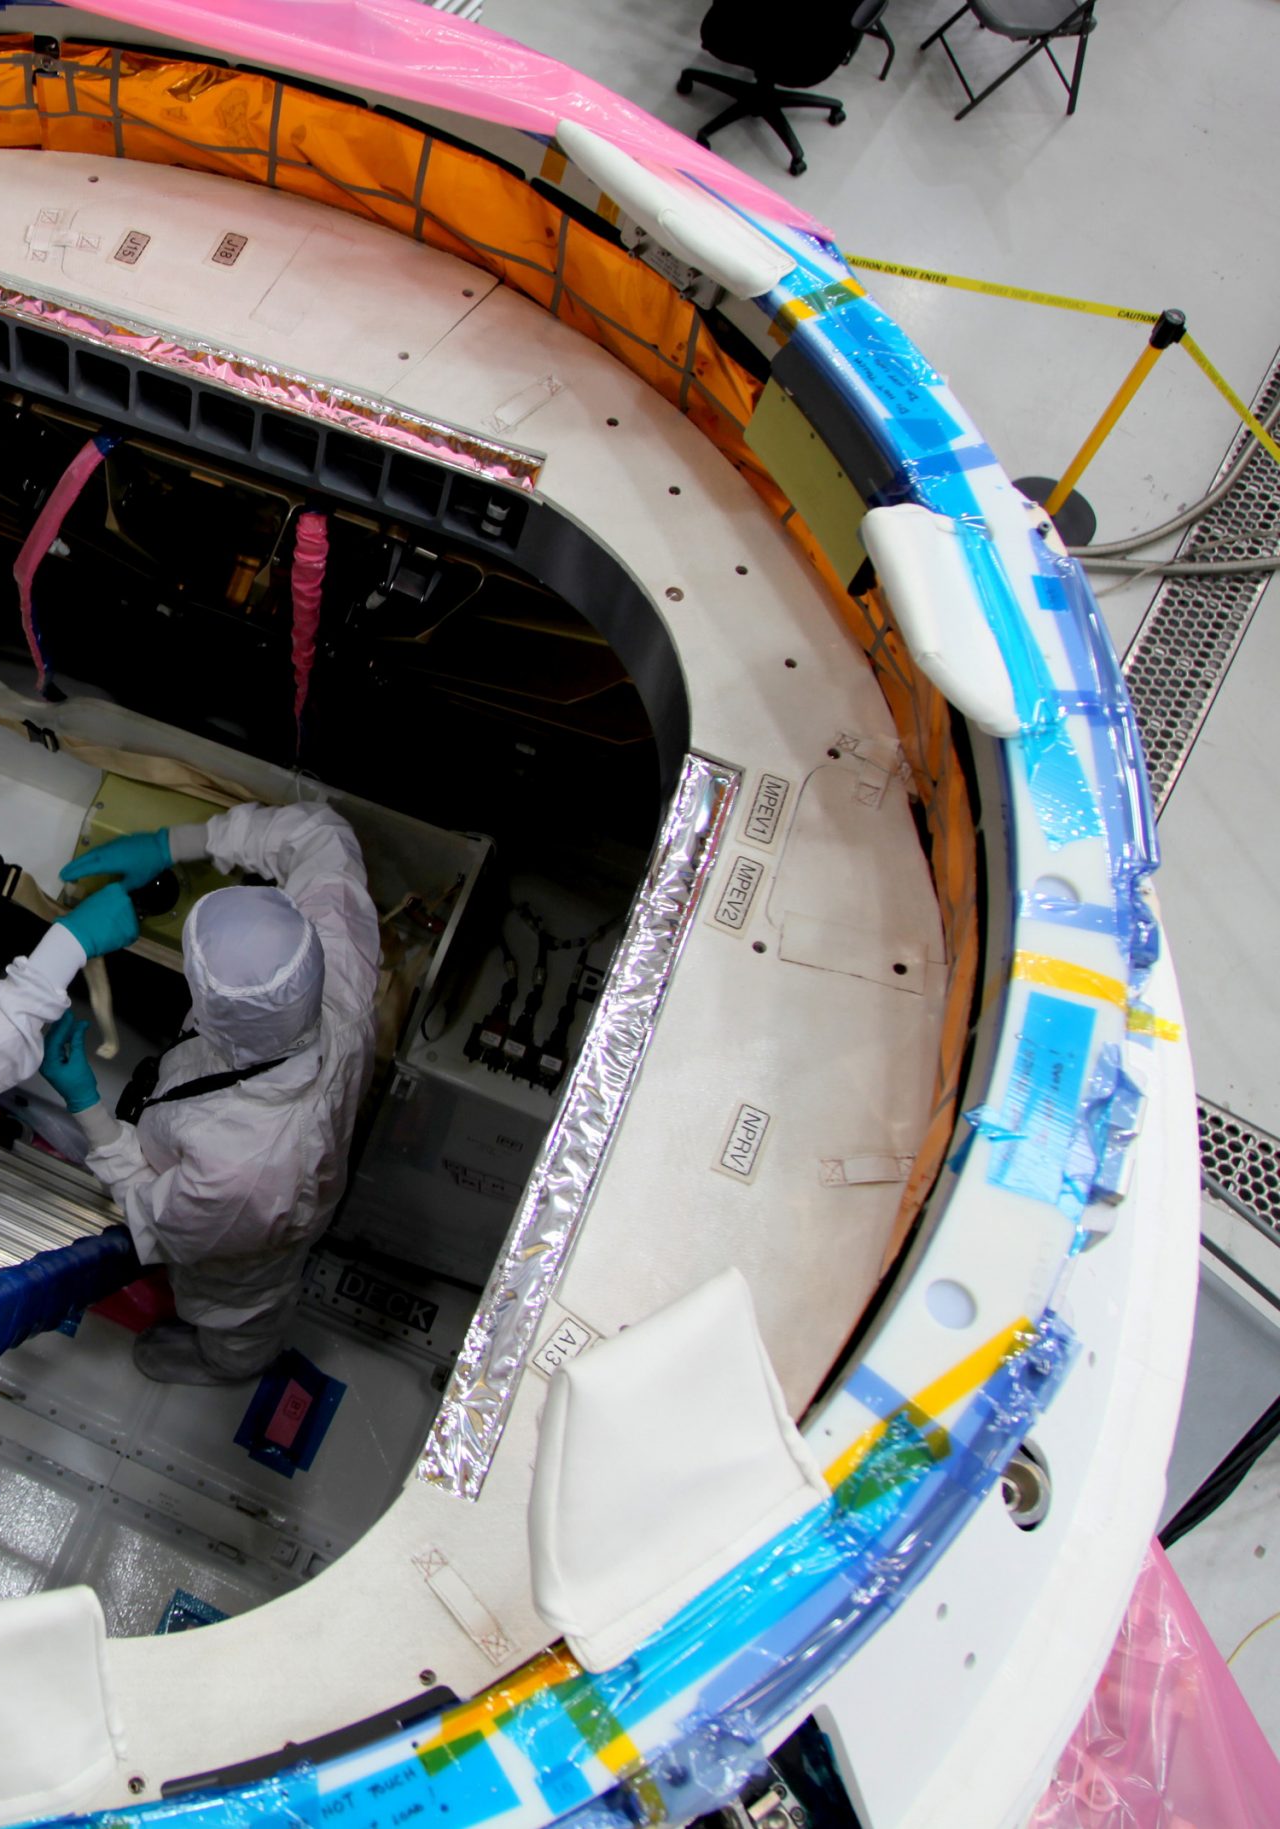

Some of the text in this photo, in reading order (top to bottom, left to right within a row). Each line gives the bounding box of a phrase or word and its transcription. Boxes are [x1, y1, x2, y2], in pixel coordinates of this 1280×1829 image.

[122, 237, 141, 258] J15
[220, 239, 239, 260] J18
[900, 267, 919, 279] NOT
[920, 272, 949, 285] ENTER
[1117, 310, 1159, 324] CAUTION
[751, 780, 782, 836] MPEV1
[722, 863, 757, 921] MPEV2
[730, 1112, 762, 1168] NPRV
[342, 1272, 434, 1329] DECK
[545, 1328, 577, 1367] A13
[322, 1791, 355, 1819] NOT
